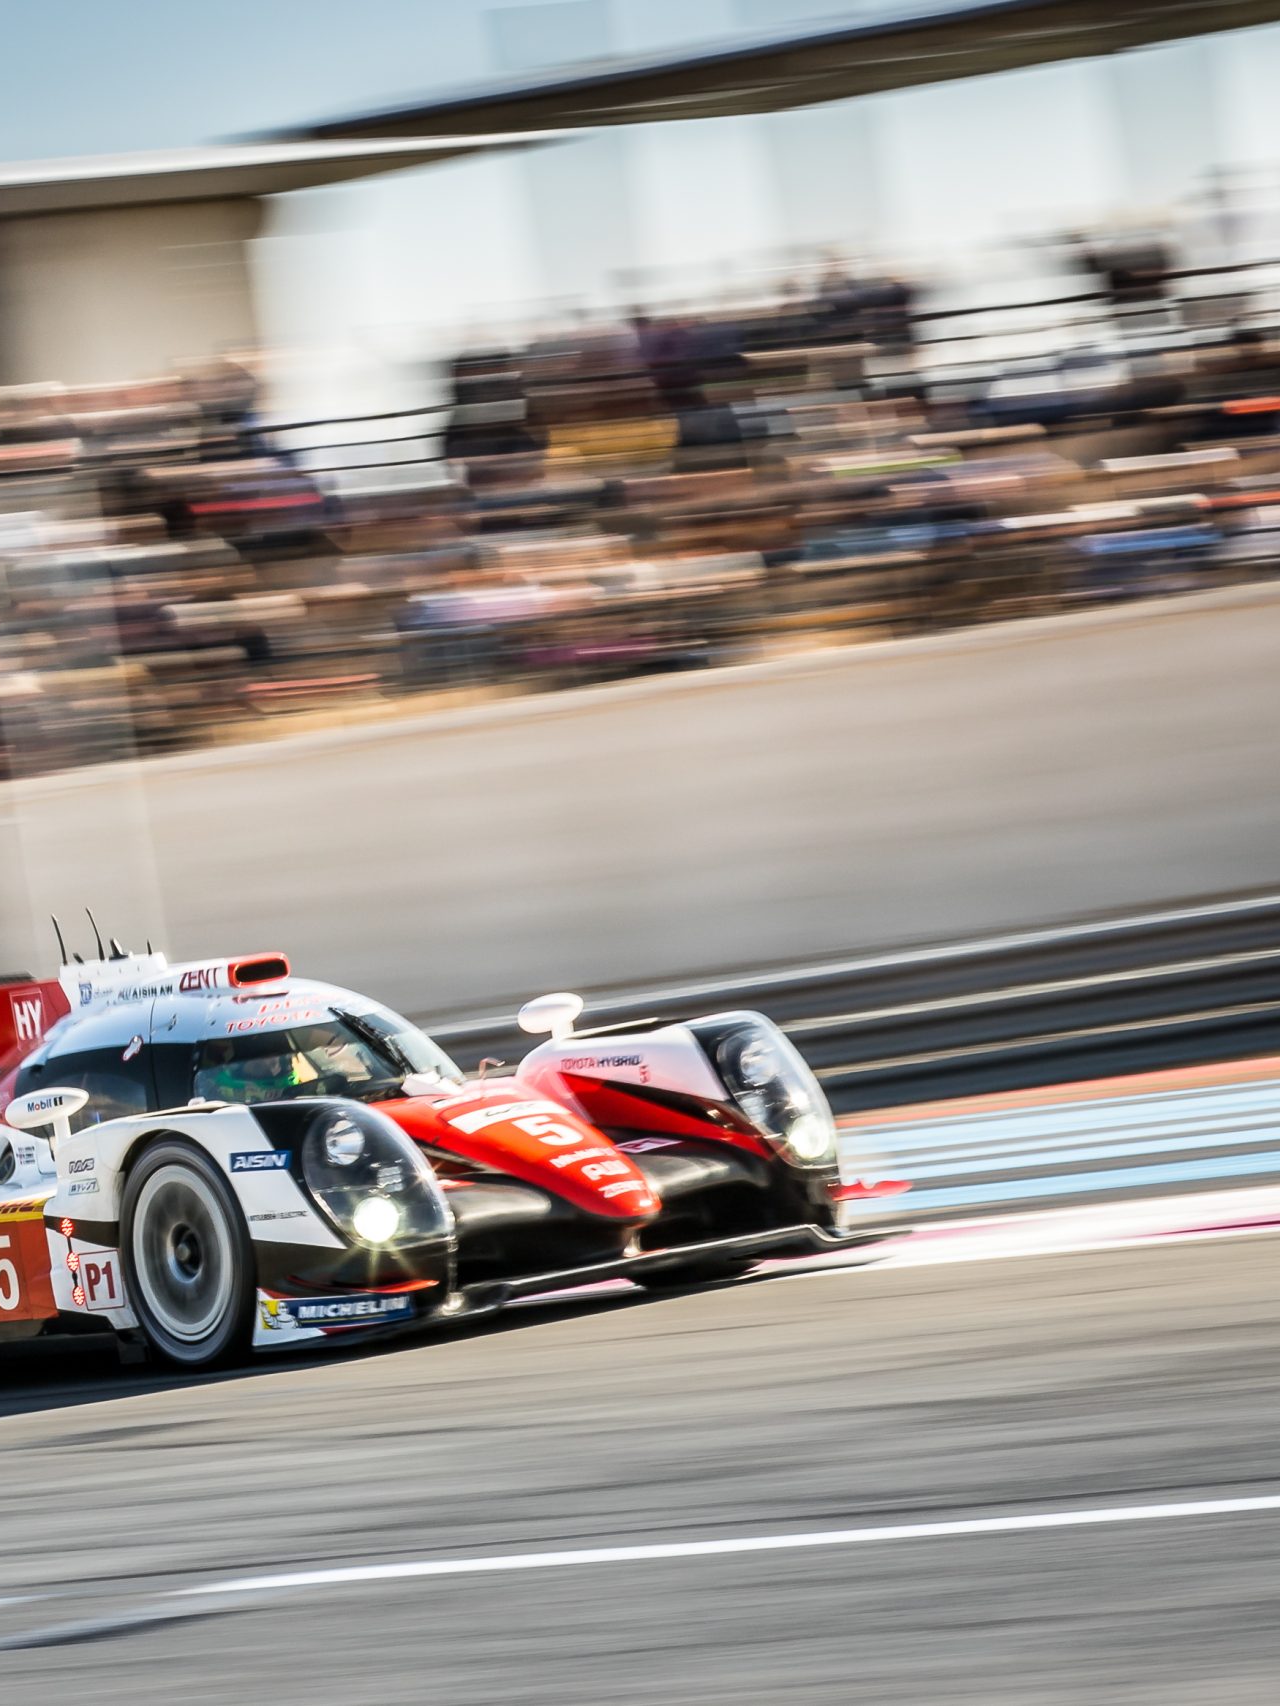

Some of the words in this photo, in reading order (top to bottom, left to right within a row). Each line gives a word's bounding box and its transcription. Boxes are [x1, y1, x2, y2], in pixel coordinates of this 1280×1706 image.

[132, 986, 157, 999] AISIN
[159, 984, 173, 996] AW
[179, 967, 222, 993] ZENT
[13, 999, 41, 1040] HY
[560, 1057, 595, 1070] TOYOTA
[596, 1055, 642, 1068] HYBRID
[27, 1099, 52, 1112] Mobil
[511, 1115, 584, 1146] 5
[233, 1153, 287, 1169] AISIN
[85, 1261, 116, 1301] P1
[298, 1296, 410, 1319] MICHELIN
